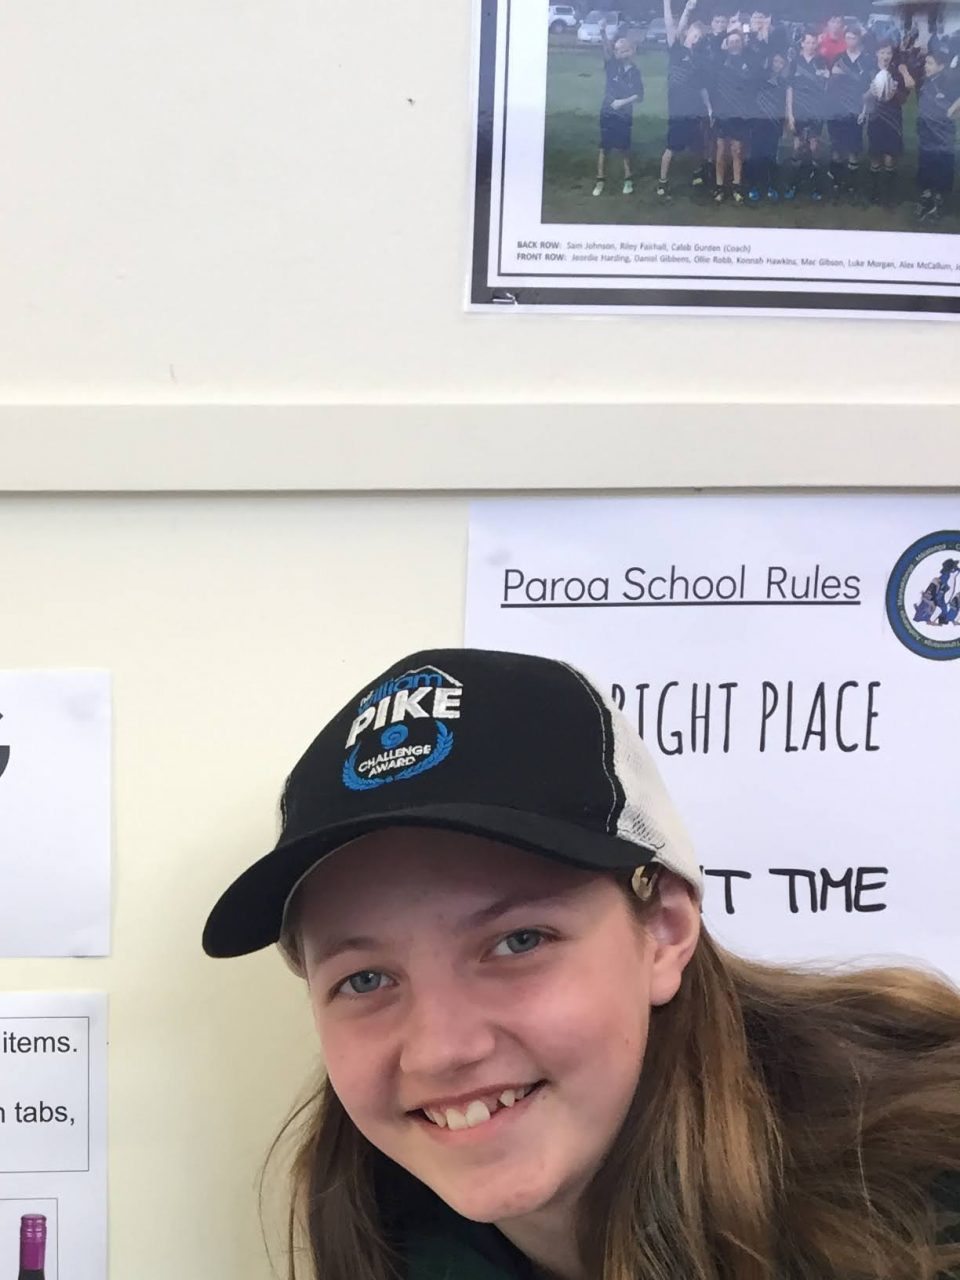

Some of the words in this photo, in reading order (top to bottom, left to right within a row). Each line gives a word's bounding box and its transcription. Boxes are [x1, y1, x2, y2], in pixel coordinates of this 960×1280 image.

[517, 241, 539, 249] BACK
[517, 253, 542, 261] FRONT
[503, 568, 609, 602] Paroa
[622, 565, 745, 600] School
[766, 566, 861, 599] Rules
[345, 686, 463, 749] PIKE
[759, 680, 881, 753] PLACE
[358, 744, 432, 773] CHALLENGE
[368, 756, 416, 778] AWARD
[768, 866, 889, 914] TIME
[2, 1030, 80, 1055] items.
[14, 1100, 77, 1127] tabs,
